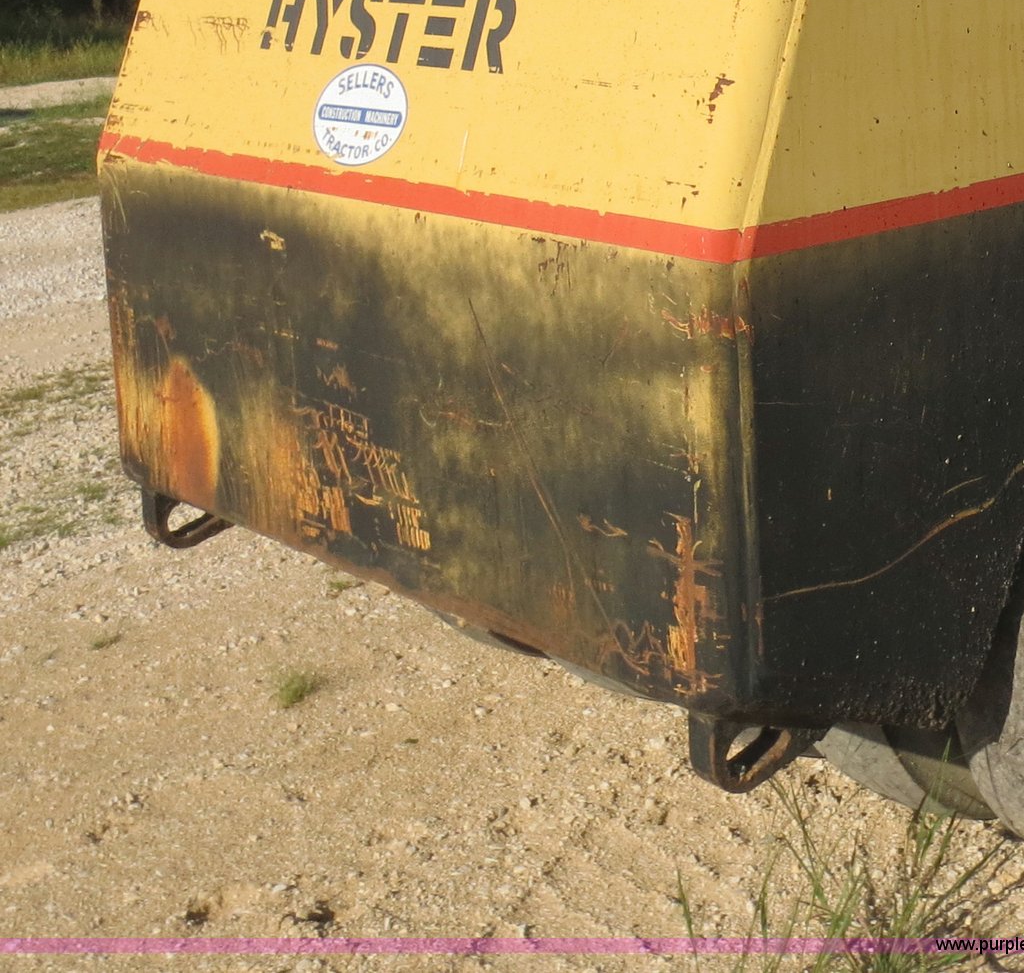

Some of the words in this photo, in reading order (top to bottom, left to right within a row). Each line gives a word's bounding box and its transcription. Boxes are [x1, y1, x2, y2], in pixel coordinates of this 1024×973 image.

[338, 70, 394, 99] SELLERS
[321, 105, 361, 123] CONSTRUCTION
[364, 109, 400, 127] MACHINERY
[322, 126, 370, 159] TRACTOR
